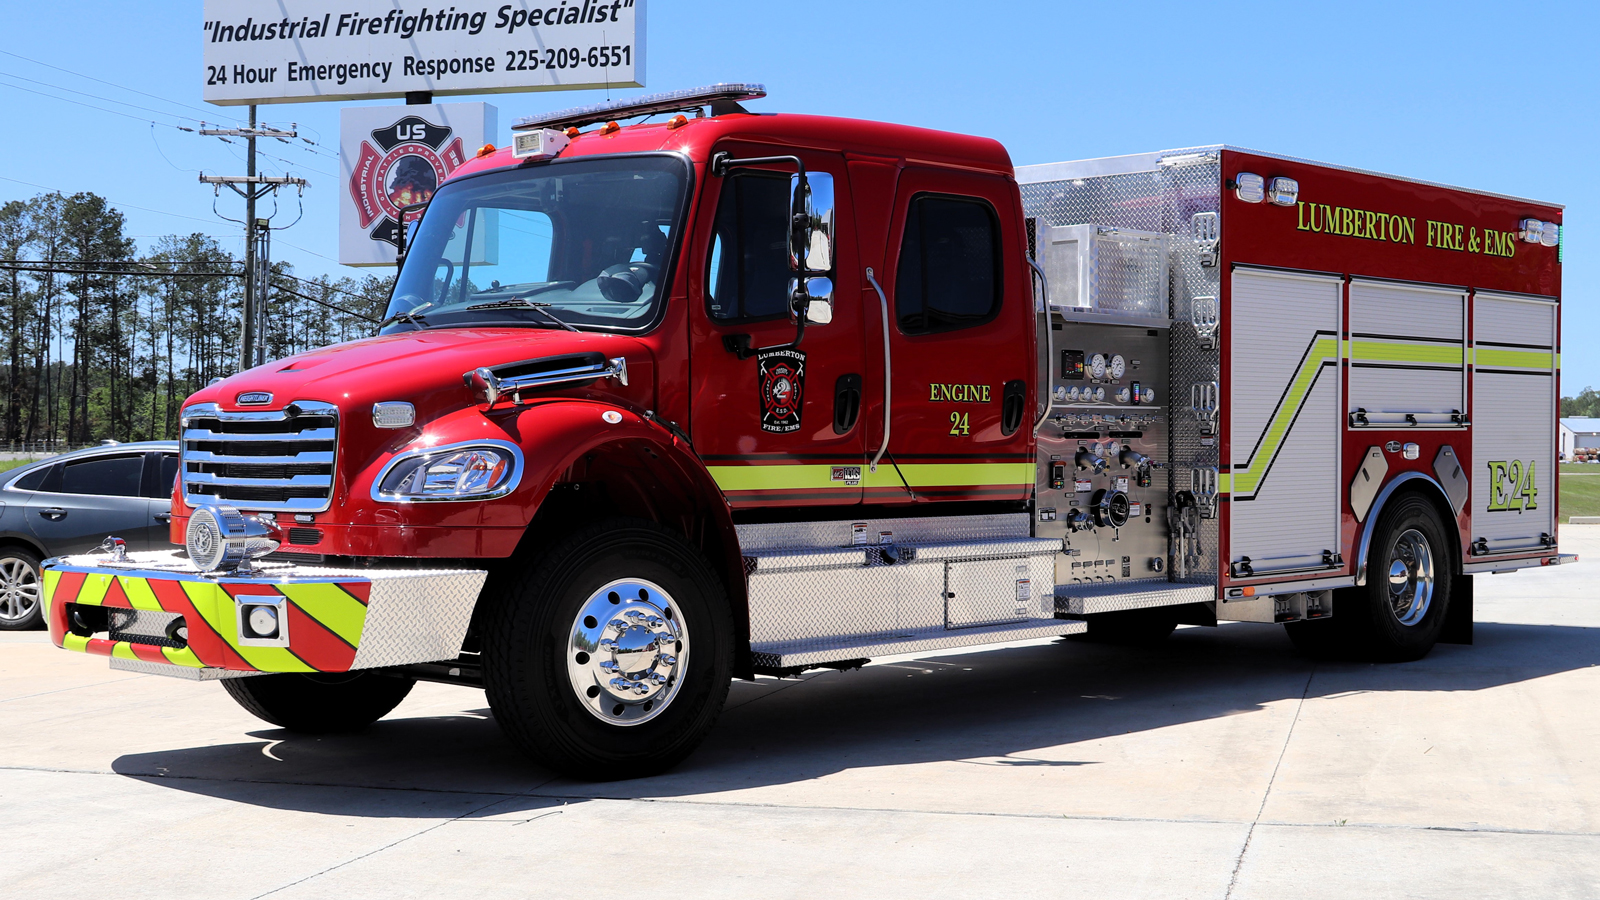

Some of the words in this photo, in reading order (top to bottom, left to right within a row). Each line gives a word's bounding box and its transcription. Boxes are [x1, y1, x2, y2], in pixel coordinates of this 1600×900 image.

[203, 13, 331, 43] "Industrial
[335, 6, 487, 40] Firefighting
[494, 0, 634, 33] Specialist"
[207, 65, 228, 86] 24
[233, 64, 278, 85] Hour
[288, 61, 393, 85] Emergency
[403, 55, 495, 80] Response
[505, 45, 631, 71] 225-209-6551
[396, 123, 426, 140] US
[377, 147, 404, 181] BATTLE
[417, 147, 444, 181] PROVEN
[360, 155, 375, 217] INDUSTRIAL
[1297, 201, 1416, 245] LUMBERTON
[1426, 220, 1464, 251] FIRE
[1468, 226, 1481, 253] &
[1484, 229, 1515, 258] EMS
[758, 350, 805, 361] LUMBERTON
[776, 381, 787, 398] 2
[930, 384, 991, 402] ENGINE
[950, 411, 970, 435] 24
[1487, 460, 1538, 513] E24
